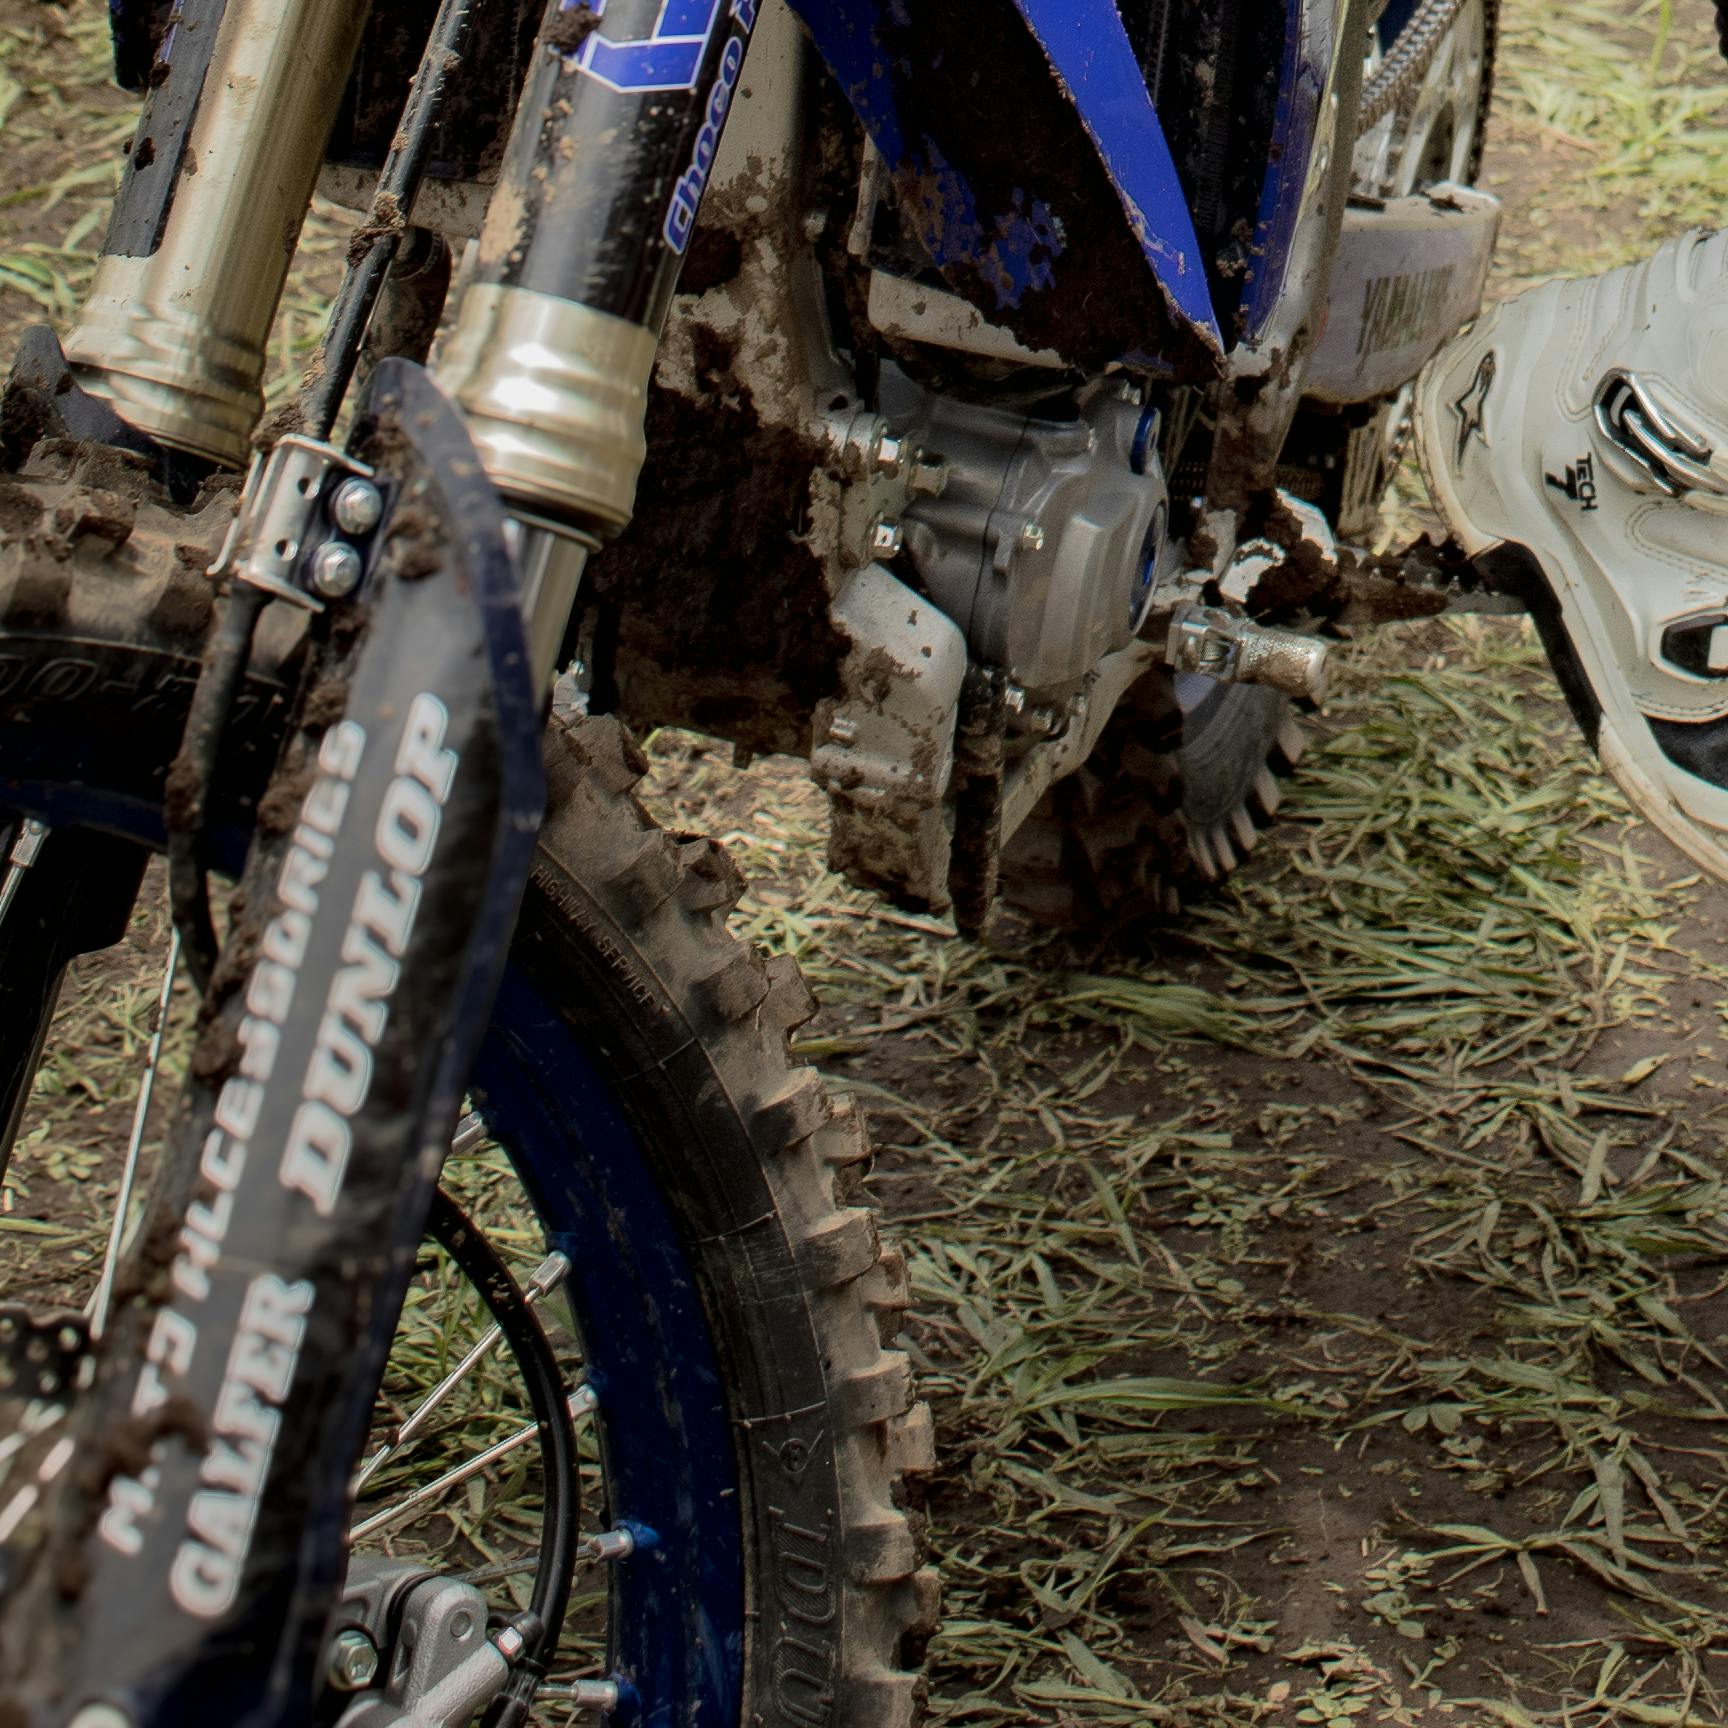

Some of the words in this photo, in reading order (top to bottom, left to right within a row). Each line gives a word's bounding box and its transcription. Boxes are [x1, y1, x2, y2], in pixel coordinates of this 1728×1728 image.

[663, 35, 744, 255] Choco
[1575, 451, 1598, 511] TECH
[170, 1272, 316, 1619] GALFER
[278, 692, 460, 1216] DUNLOP
